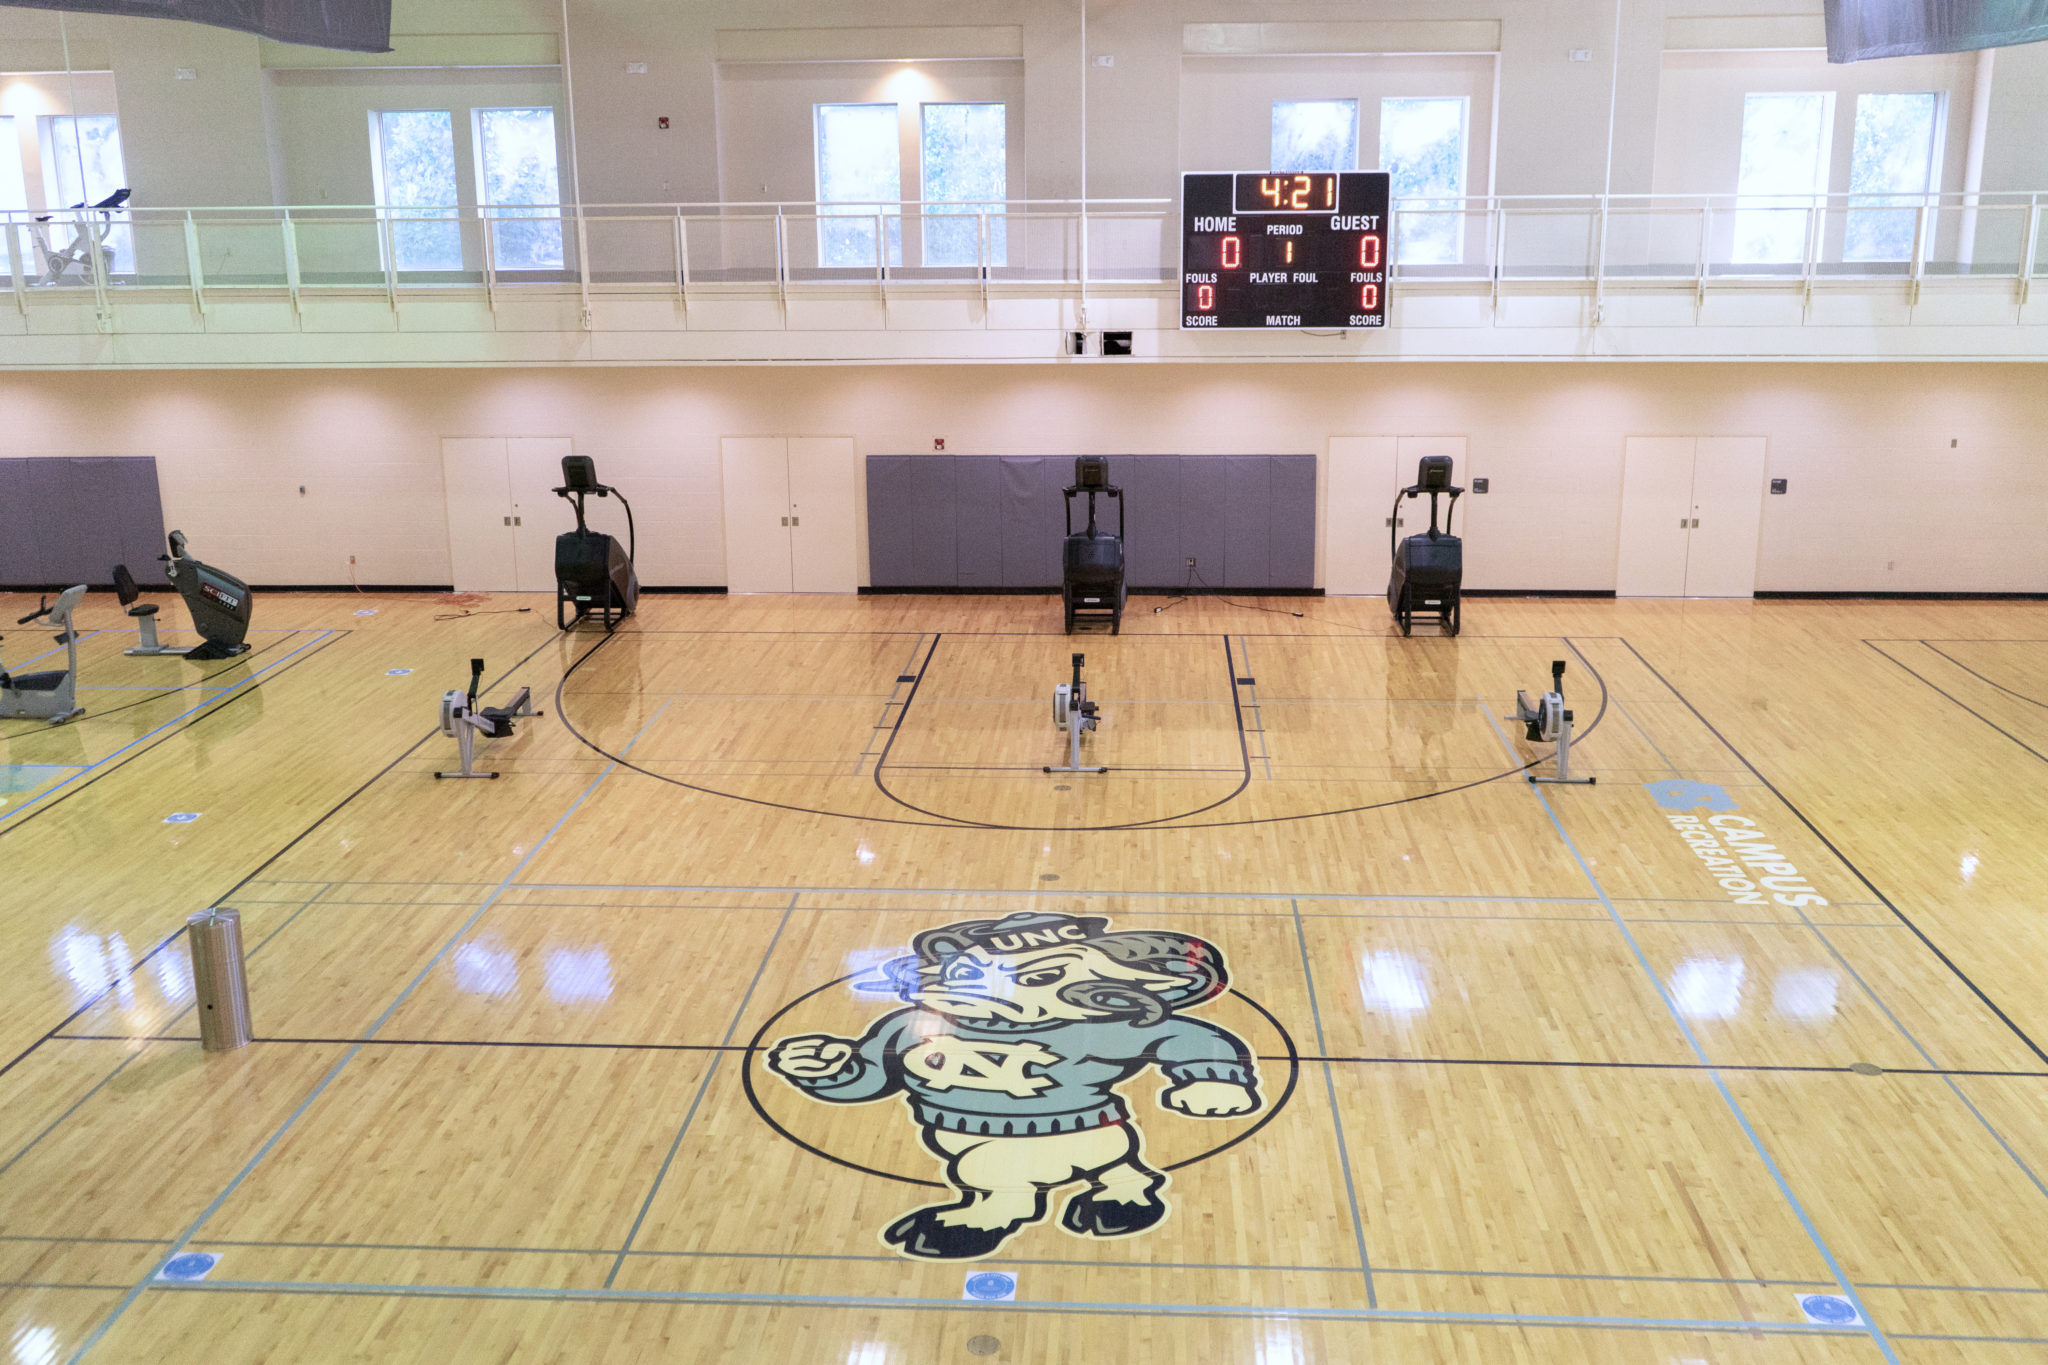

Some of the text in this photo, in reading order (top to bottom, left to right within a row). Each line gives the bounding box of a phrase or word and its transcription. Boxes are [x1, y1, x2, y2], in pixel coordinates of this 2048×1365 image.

[1261, 176, 1333, 209] 4:21
[1194, 217, 1237, 232] HOME
[1267, 225, 1303, 235] PERIOD
[1330, 215, 1379, 231] GUEST
[1221, 236, 1240, 269] 0
[1285, 241, 1293, 264] 1
[1360, 235, 1379, 267] 0
[1186, 273, 1217, 284] FOULS
[1250, 273, 1318, 283] PLAYER FOUL
[1350, 272, 1383, 283] FOULS
[1198, 285, 1213, 310] 0
[1362, 284, 1377, 309] 0
[1186, 316, 1218, 326] SCORE
[1266, 315, 1300, 326] MATCH
[1349, 315, 1382, 326] SCORE
[1666, 815, 1770, 904] RECREATION
[1708, 814, 1828, 907] CAMPUS
[991, 924, 1087, 951] UNC
